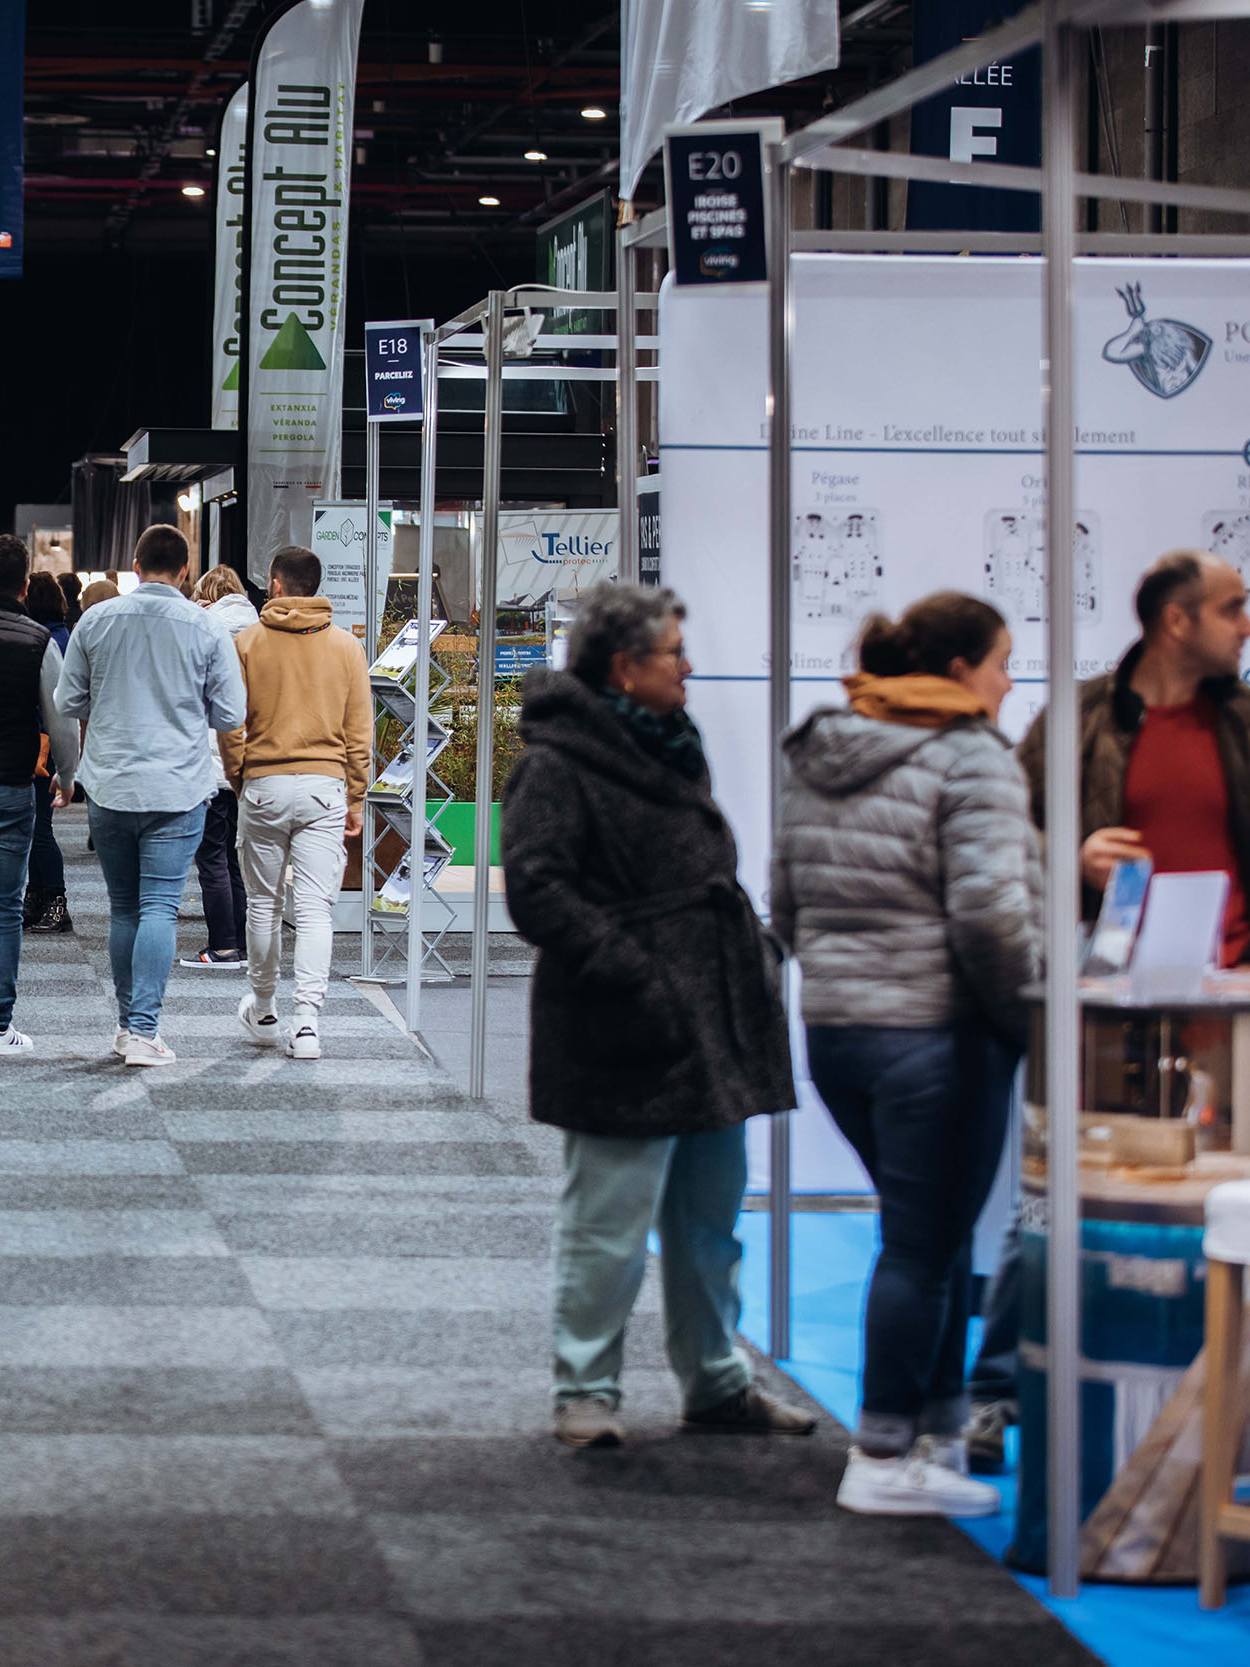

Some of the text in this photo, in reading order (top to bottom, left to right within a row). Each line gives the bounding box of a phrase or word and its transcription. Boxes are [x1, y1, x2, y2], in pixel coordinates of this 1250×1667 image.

[955, 60, 1013, 86] LLÉE
[335, 82, 346, 169] HABITAT
[950, 106, 1002, 164] F
[688, 151, 743, 181] E20
[260, 84, 342, 332] Concept Alu
[694, 194, 739, 209] IROISE
[687, 209, 747, 225] PISCINES
[691, 224, 745, 240] ET SPAS
[704, 253, 740, 267] viving
[330, 221, 342, 332] VÉRANDAS
[378, 338, 408, 355] E18
[270, 404, 317, 412] EXTANXIA
[386, 397, 406, 405] viving
[273, 417, 317, 427] VÉRANDA
[272, 433, 315, 441] PERGOLA
[825, 424, 864, 441] Line
[990, 427, 1026, 443] tout
[1031, 426, 1136, 444] silement
[811, 471, 860, 488] Pégase
[316, 530, 389, 542] GARDEN CONPTS
[541, 533, 614, 556] Tellier
[563, 558, 592, 566] protec
